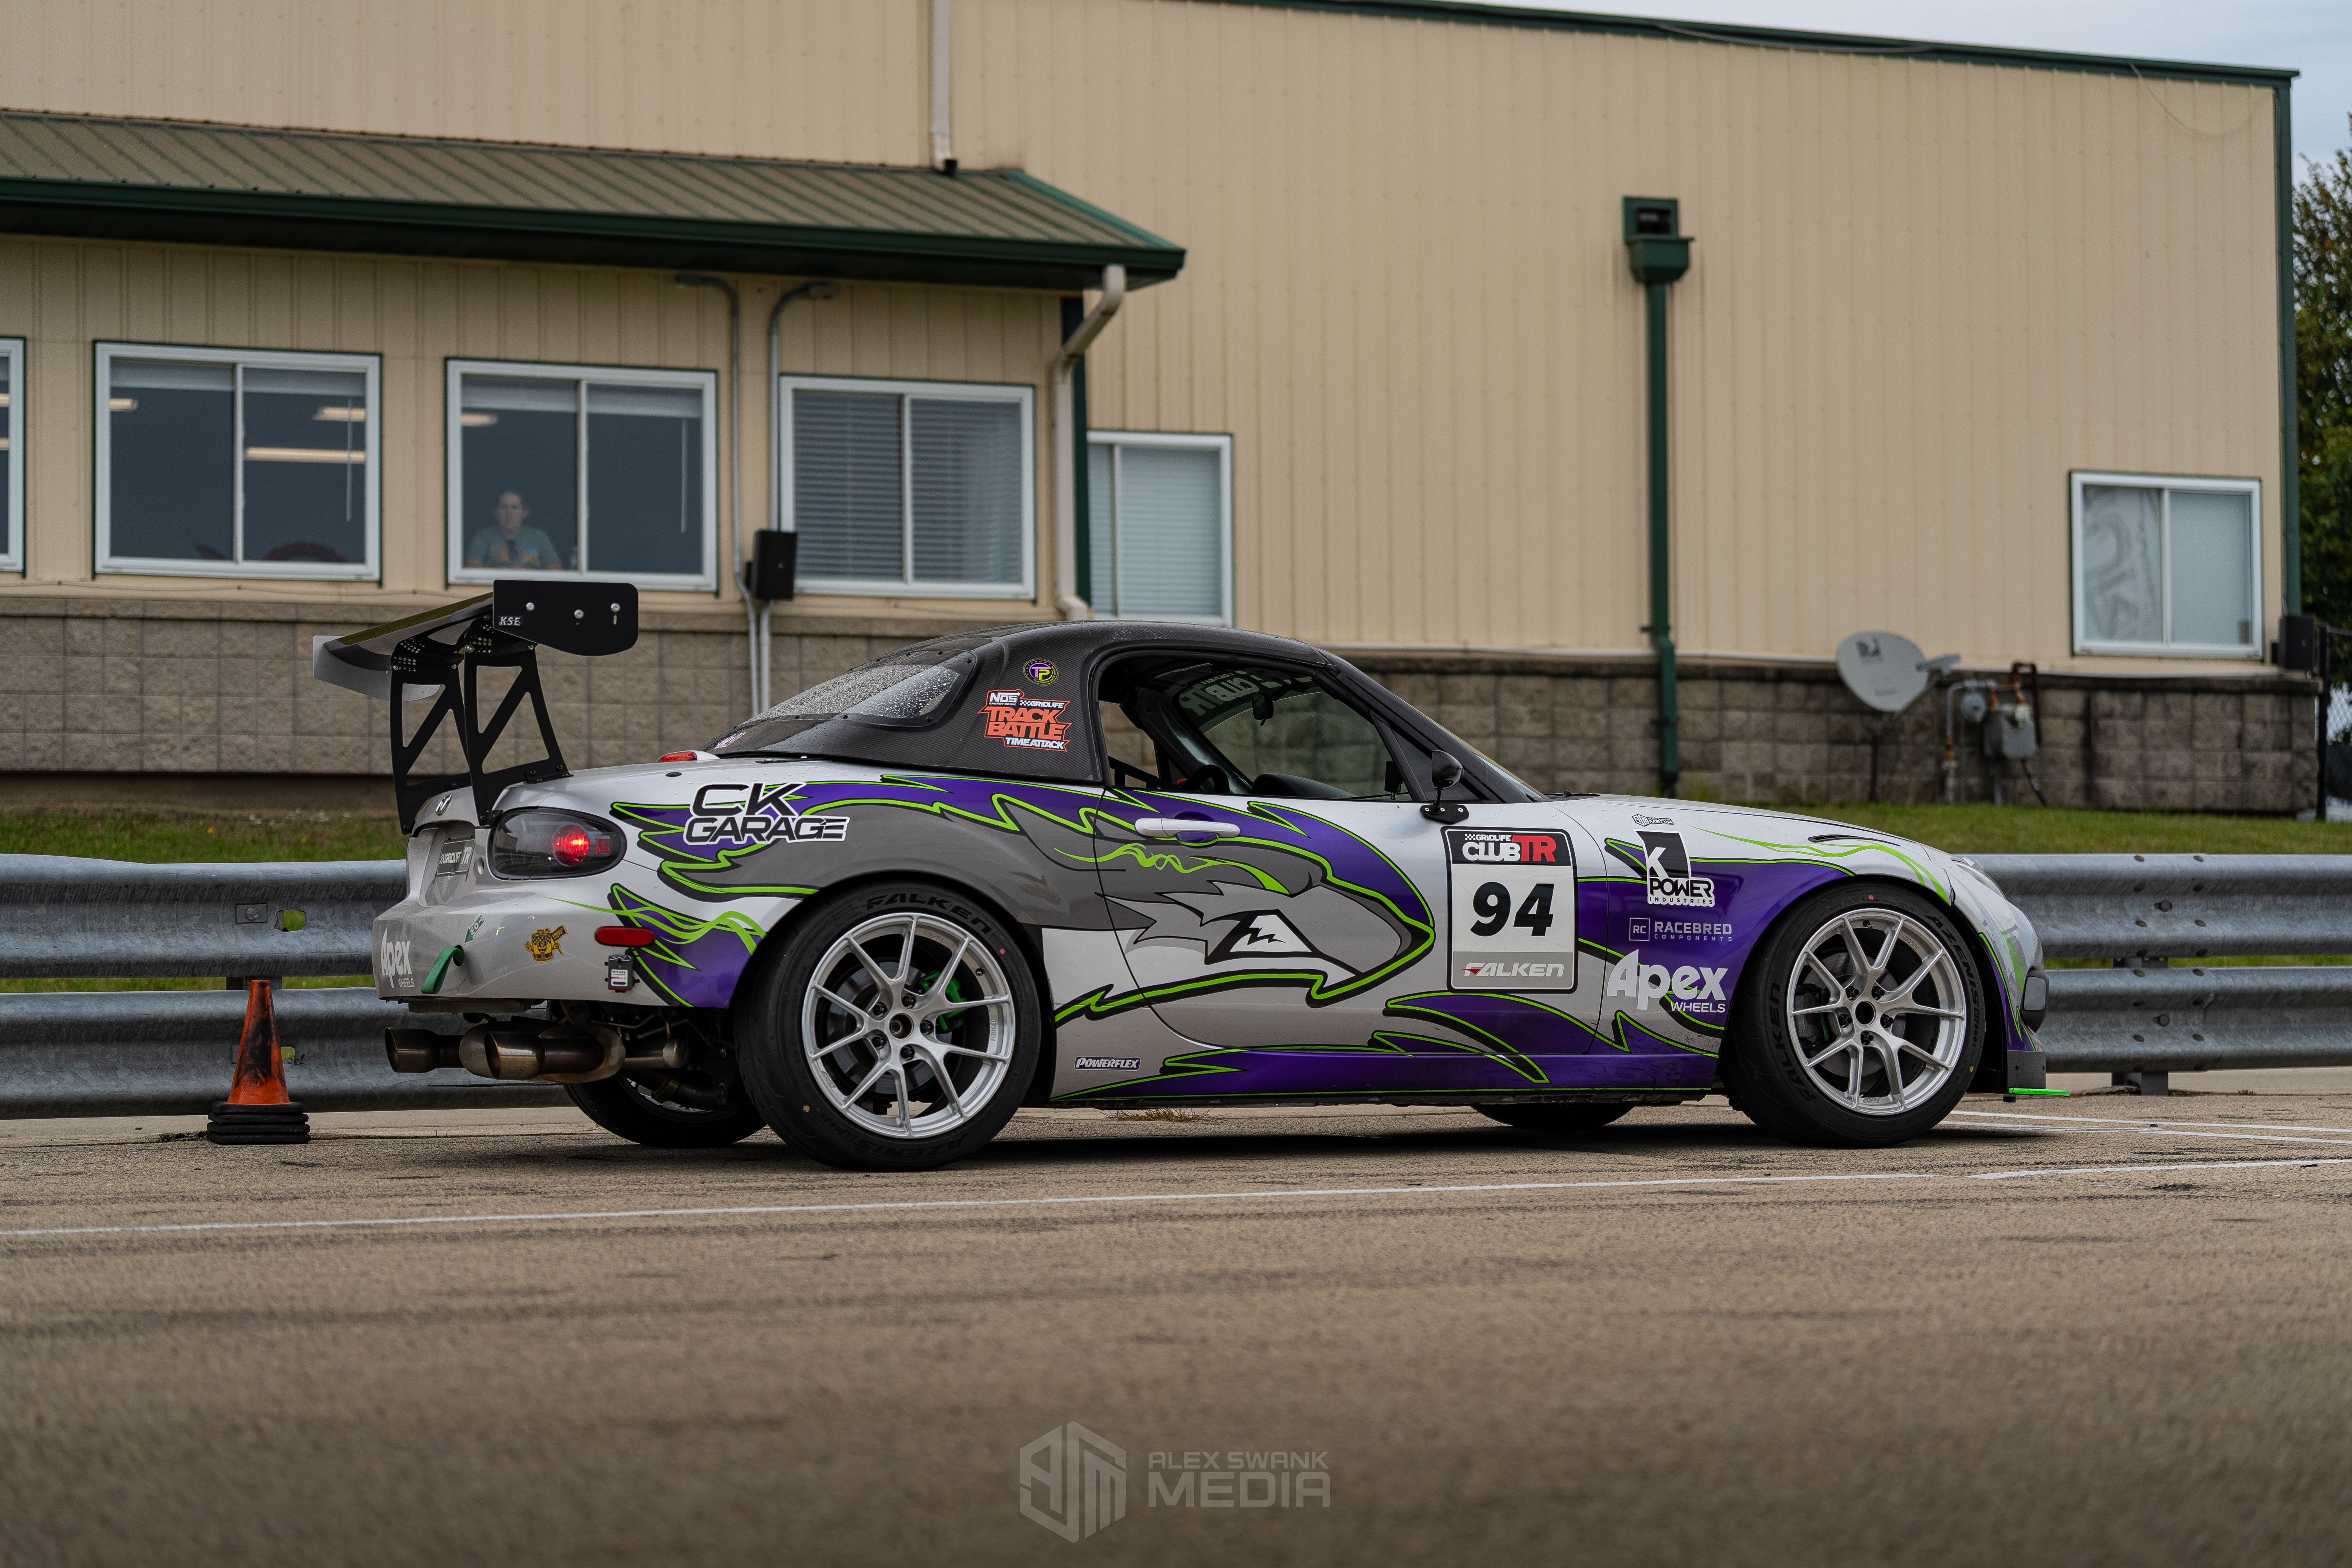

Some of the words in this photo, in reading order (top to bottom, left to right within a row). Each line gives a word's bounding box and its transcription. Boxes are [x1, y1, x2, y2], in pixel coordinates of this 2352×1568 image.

[989, 692, 1021, 703] NOS
[984, 707, 1060, 723] TRACK
[988, 722, 1066, 740] BATTLE
[1005, 737, 1031, 746] TIME
[1029, 739, 1065, 749] ATTACK
[692, 782, 805, 817] CK
[685, 816, 848, 842] GARAGE
[461, 847, 472, 864] TR
[1462, 841, 1521, 862] CLUB
[1512, 835, 1557, 862] TR
[1649, 878, 1713, 898] POWER
[861, 893, 993, 935] FALKEN
[1470, 882, 1555, 937] 94
[470, 917, 484, 935] TOW
[1633, 925, 1646, 934] RC
[1654, 921, 1732, 935] RACEBRED
[1902, 935, 1920, 950] FORGED
[381, 927, 413, 988] Apex
[1923, 914, 1980, 1009] AZENIS
[1462, 963, 1565, 977] FALKEN
[398, 978, 415, 988] WHEELS
[1606, 949, 1729, 1010] Apex
[1670, 1002, 1726, 1013] WHEELS
[1770, 982, 1817, 1104] FALKEN
[1075, 1057, 1139, 1068] POWERFLEX
[851, 1132, 969, 1158] AZENIS
